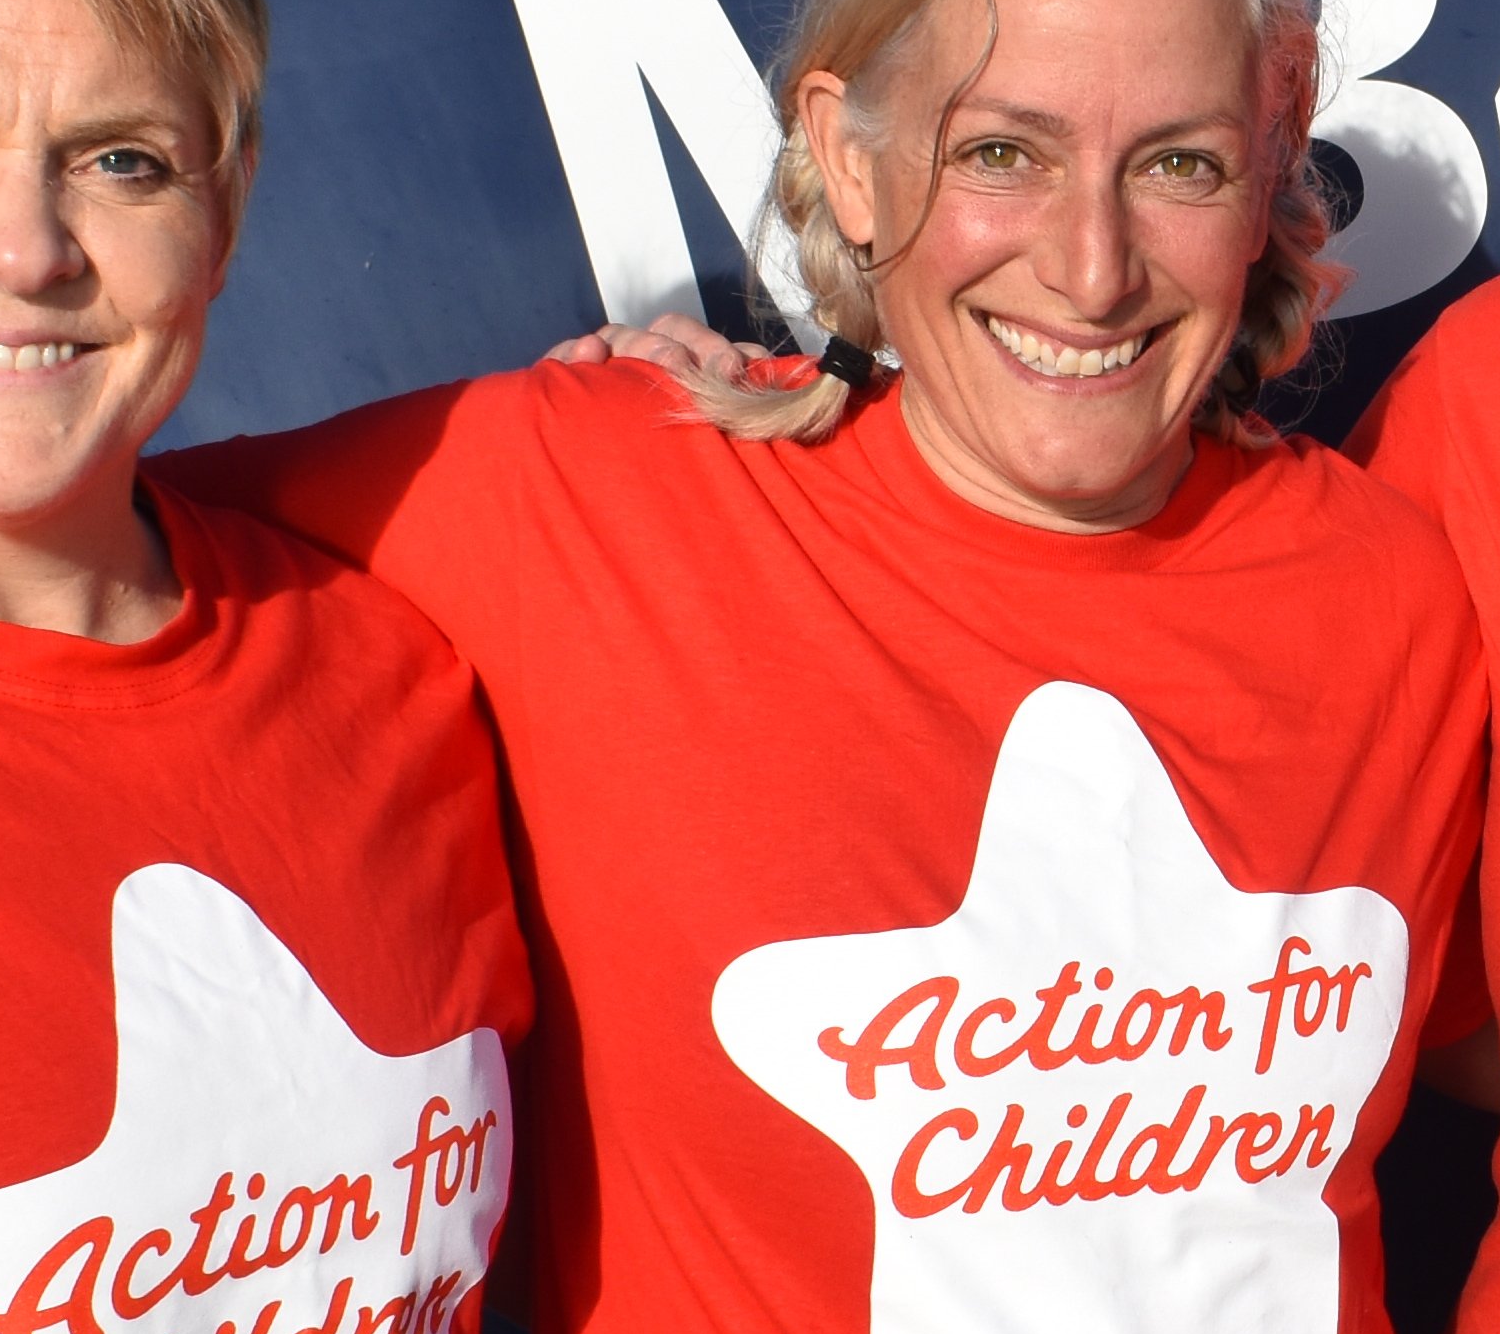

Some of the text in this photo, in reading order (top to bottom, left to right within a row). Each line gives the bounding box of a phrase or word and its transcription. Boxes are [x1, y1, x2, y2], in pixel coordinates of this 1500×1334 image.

[817, 936, 1372, 1100] Action for
[393, 1095, 497, 1256] for
[891, 1085, 1334, 1219] Children
